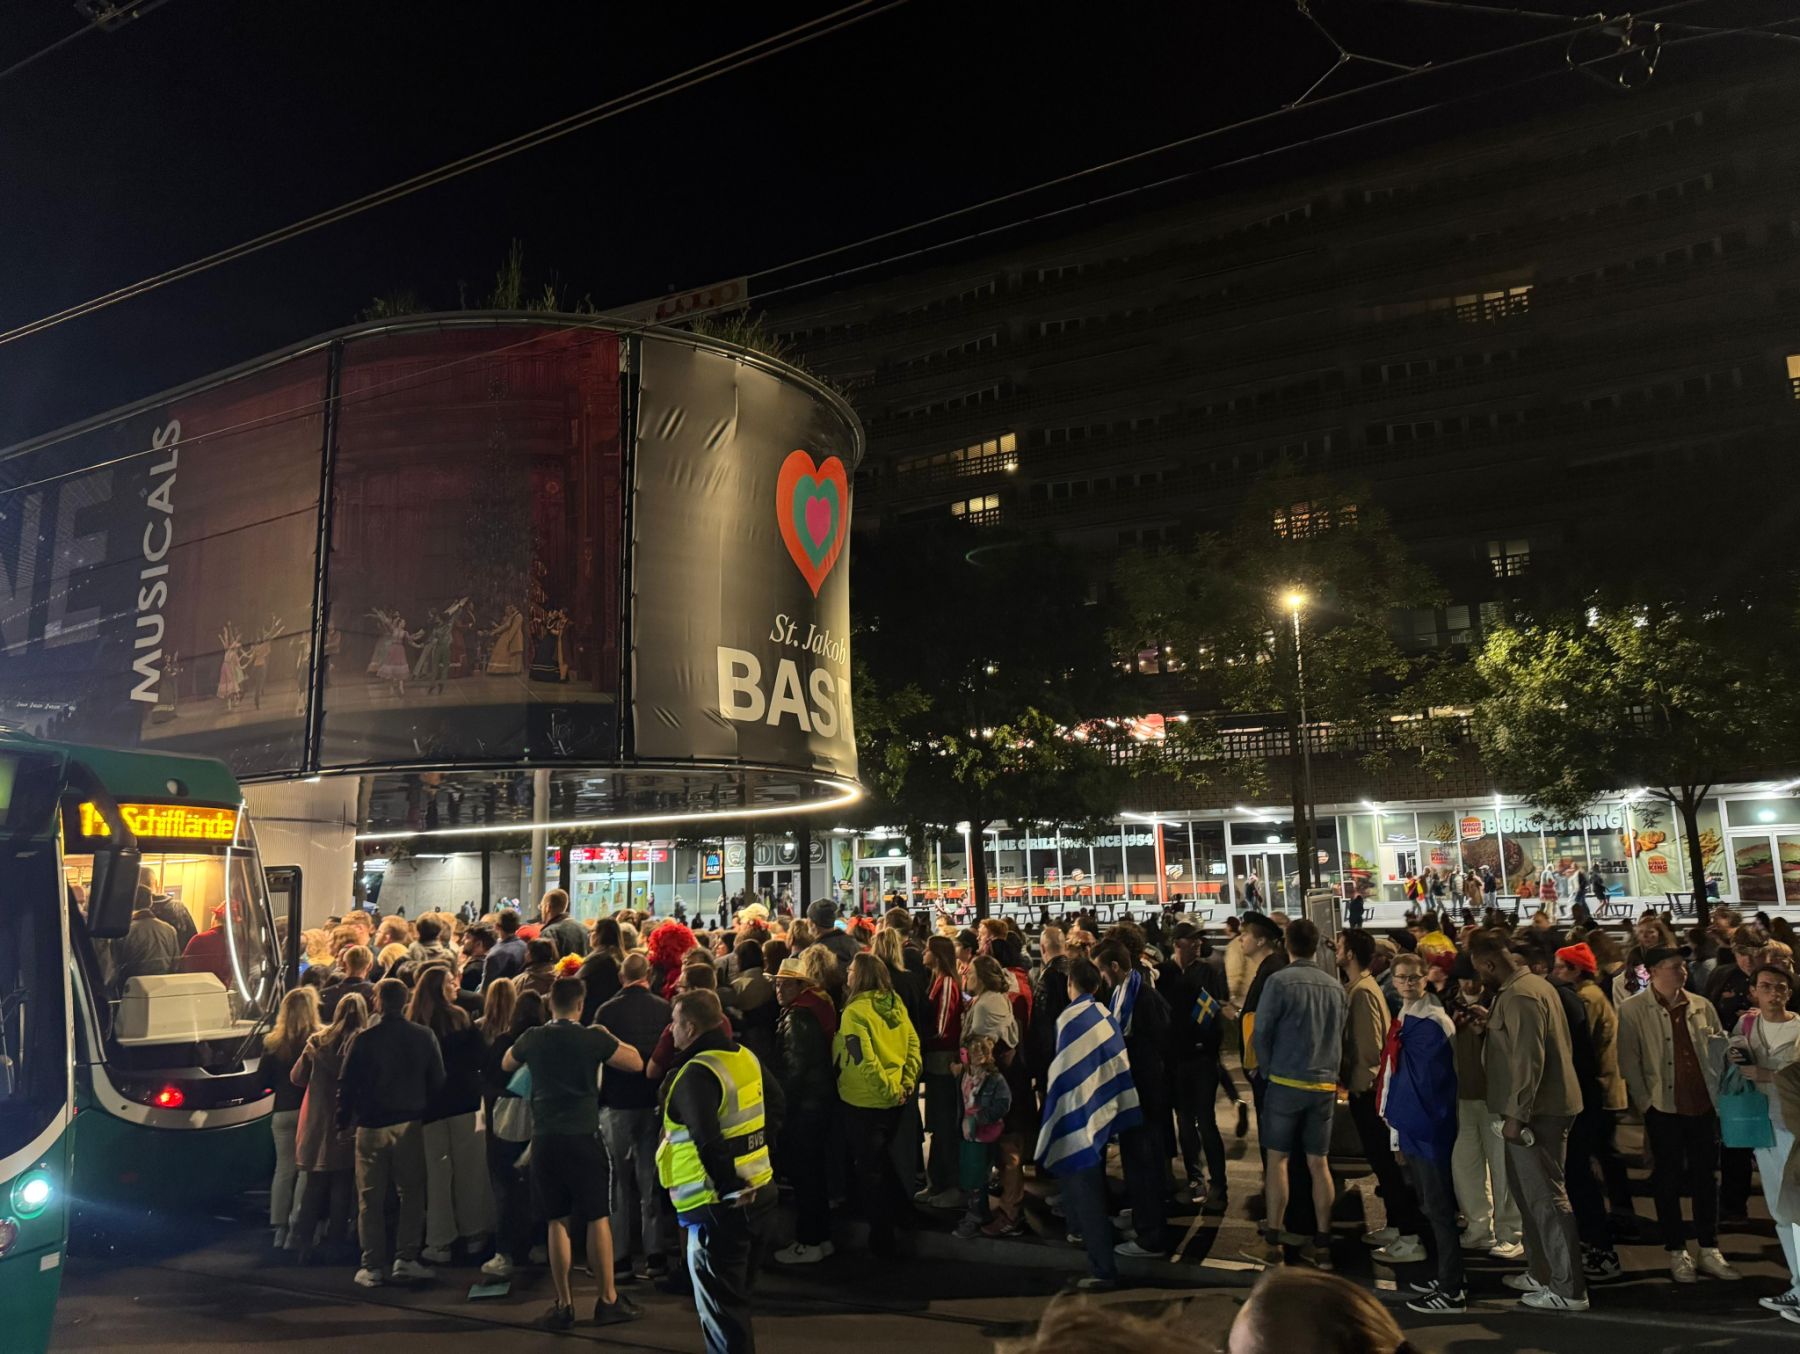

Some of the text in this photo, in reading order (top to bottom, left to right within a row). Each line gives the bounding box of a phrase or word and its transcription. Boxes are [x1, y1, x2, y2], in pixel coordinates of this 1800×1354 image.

[131, 419, 181, 703] MUSICALS
[769, 614, 846, 665] St. Jakob
[119, 805, 235, 839] Schifflände
[1486, 815, 1567, 833] BURGER
[983, 838, 1017, 851] LAME
[1123, 833, 1155, 847] 1954
